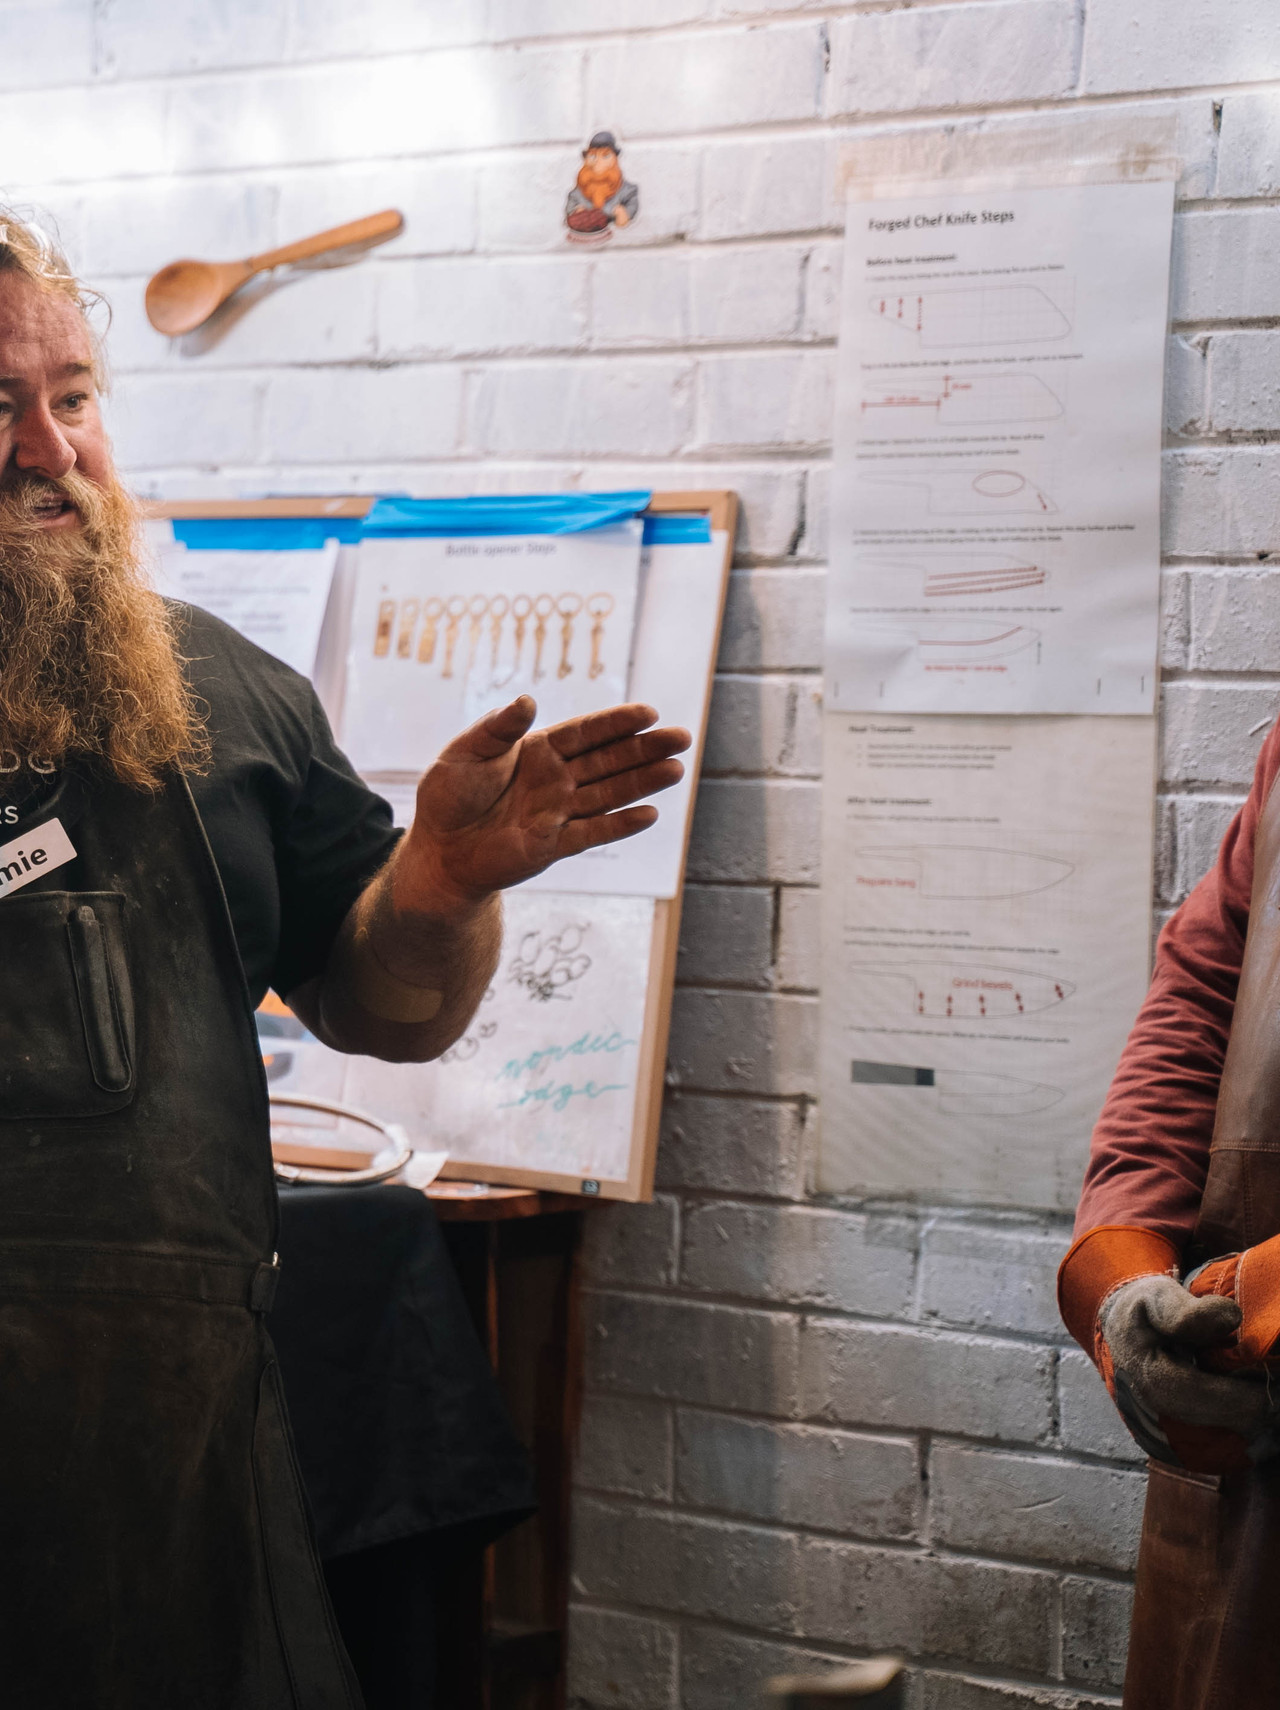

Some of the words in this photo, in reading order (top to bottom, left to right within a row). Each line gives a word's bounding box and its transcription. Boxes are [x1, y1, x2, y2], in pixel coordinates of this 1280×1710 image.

[868, 216, 910, 232] Forged
[914, 213, 942, 228] Chef
[946, 211, 977, 225] Knife
[981, 210, 1014, 224] Steps
